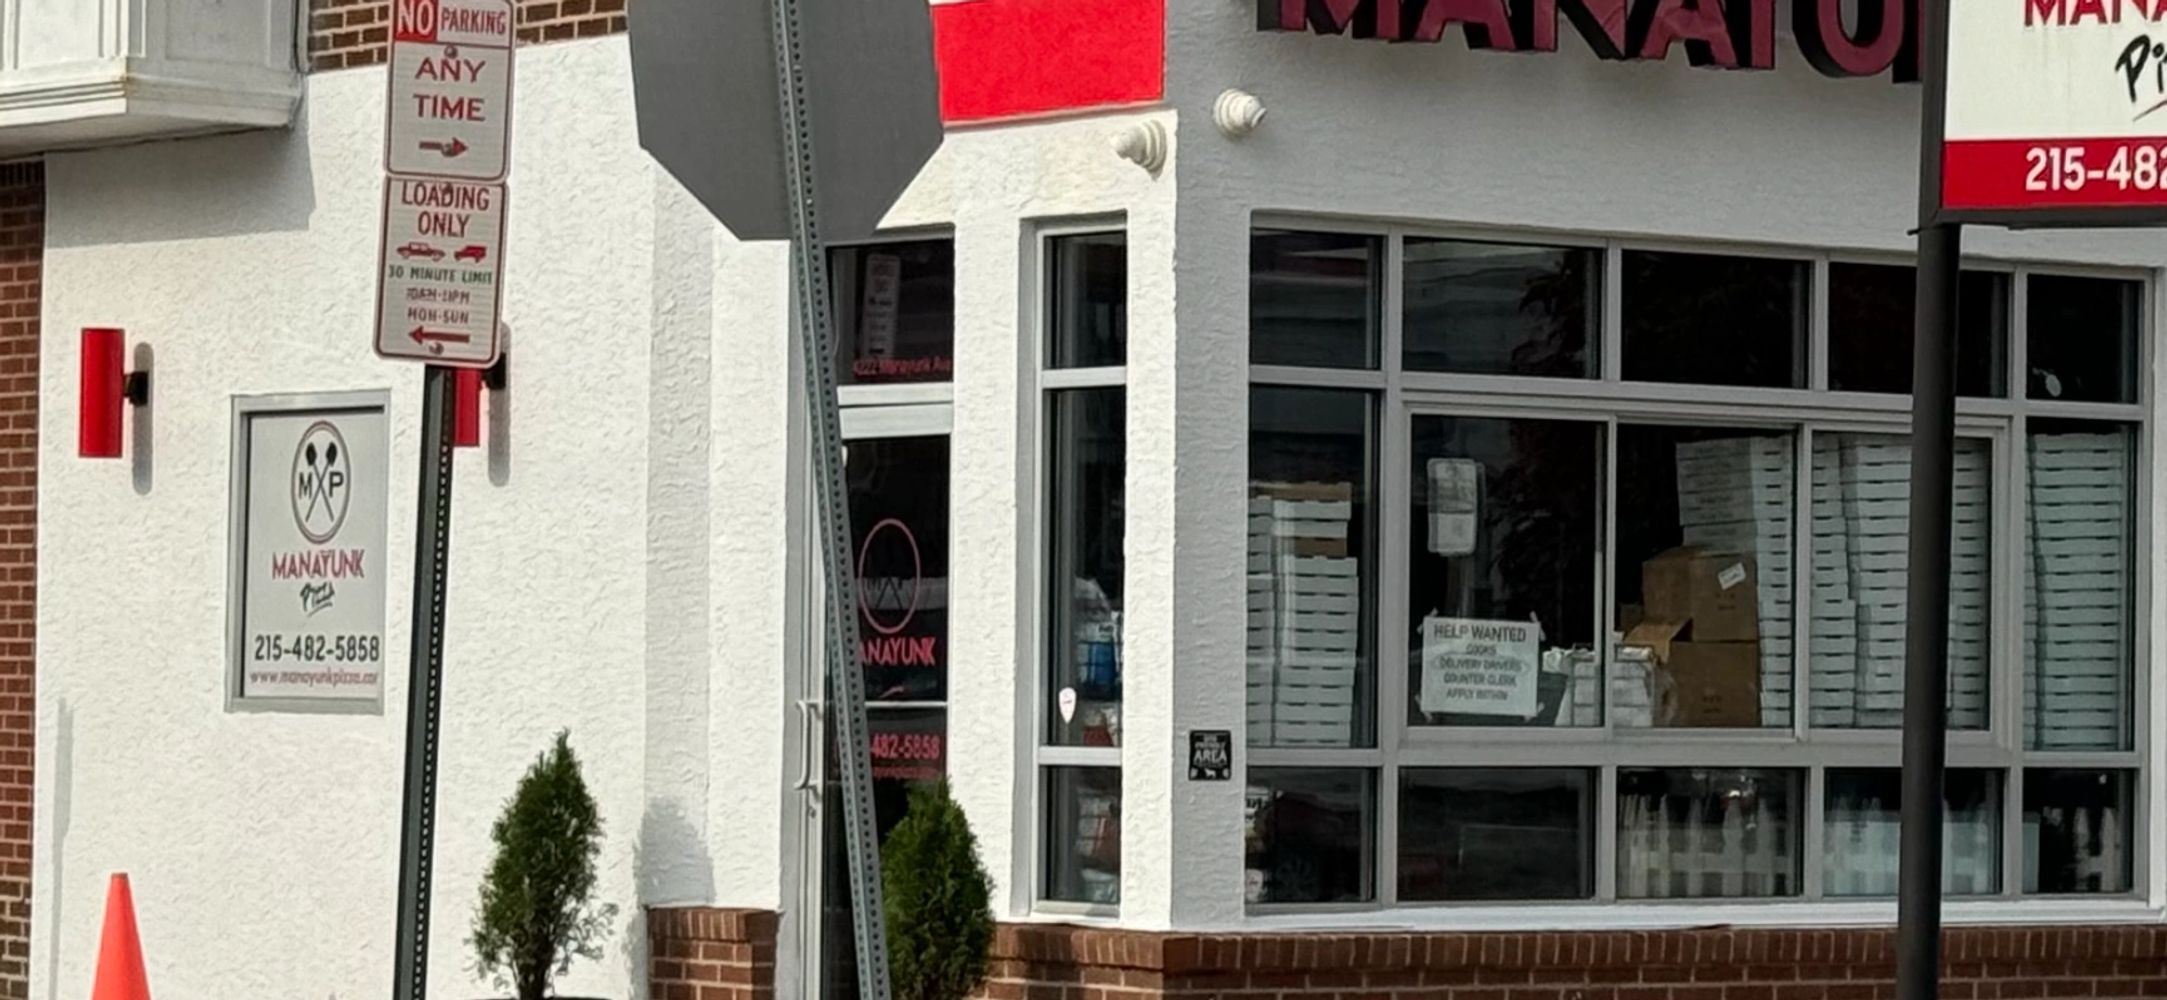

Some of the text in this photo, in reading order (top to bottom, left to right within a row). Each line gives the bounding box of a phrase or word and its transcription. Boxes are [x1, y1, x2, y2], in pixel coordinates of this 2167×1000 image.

[396, 0, 506, 36] NO PARKING
[415, 57, 486, 83] ANY
[2115, 34, 2167, 103] Pi
[413, 94, 486, 122] TIME
[402, 180, 490, 211] LOADING
[418, 211, 471, 238] ONLY
[389, 265, 493, 285] 30 MINUTE LIMIT
[408, 307, 469, 324] MON-SUN
[299, 471, 344, 500] M P
[272, 550, 365, 579] MANAYUNK
[1434, 624, 1526, 642] HELP WANTED
[254, 634, 380, 661] 215-482-5858
[858, 637, 936, 666] ANAYUNK
[868, 733, 940, 760] 482-5858
